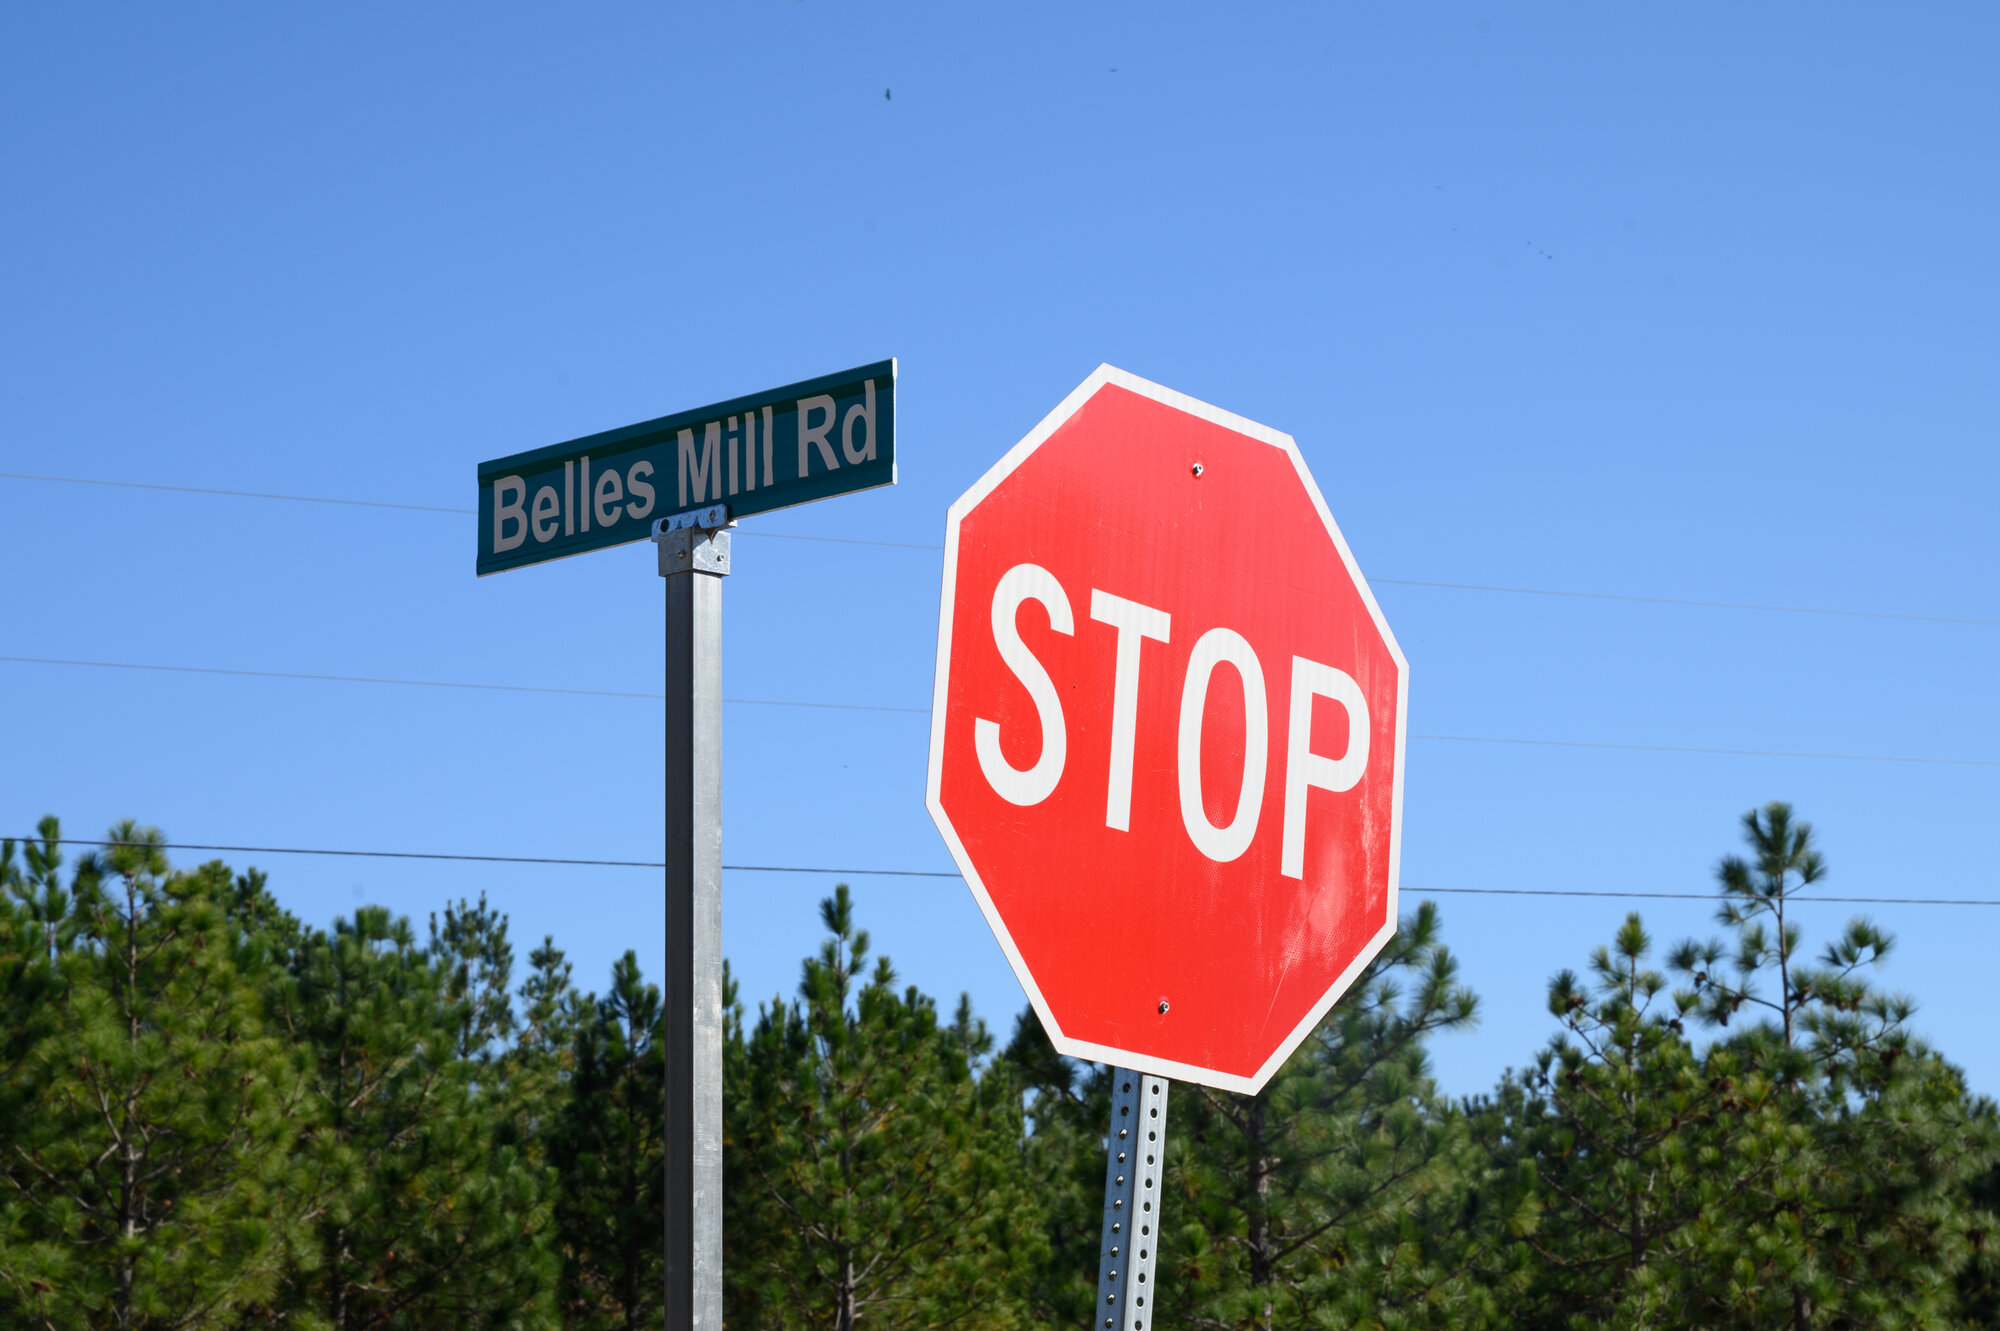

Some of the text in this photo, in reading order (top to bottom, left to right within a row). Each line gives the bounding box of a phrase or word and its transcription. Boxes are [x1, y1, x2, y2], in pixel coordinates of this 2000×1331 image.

[493, 379, 877, 554] Belles Mill Rd
[974, 563, 1370, 880] STOP
